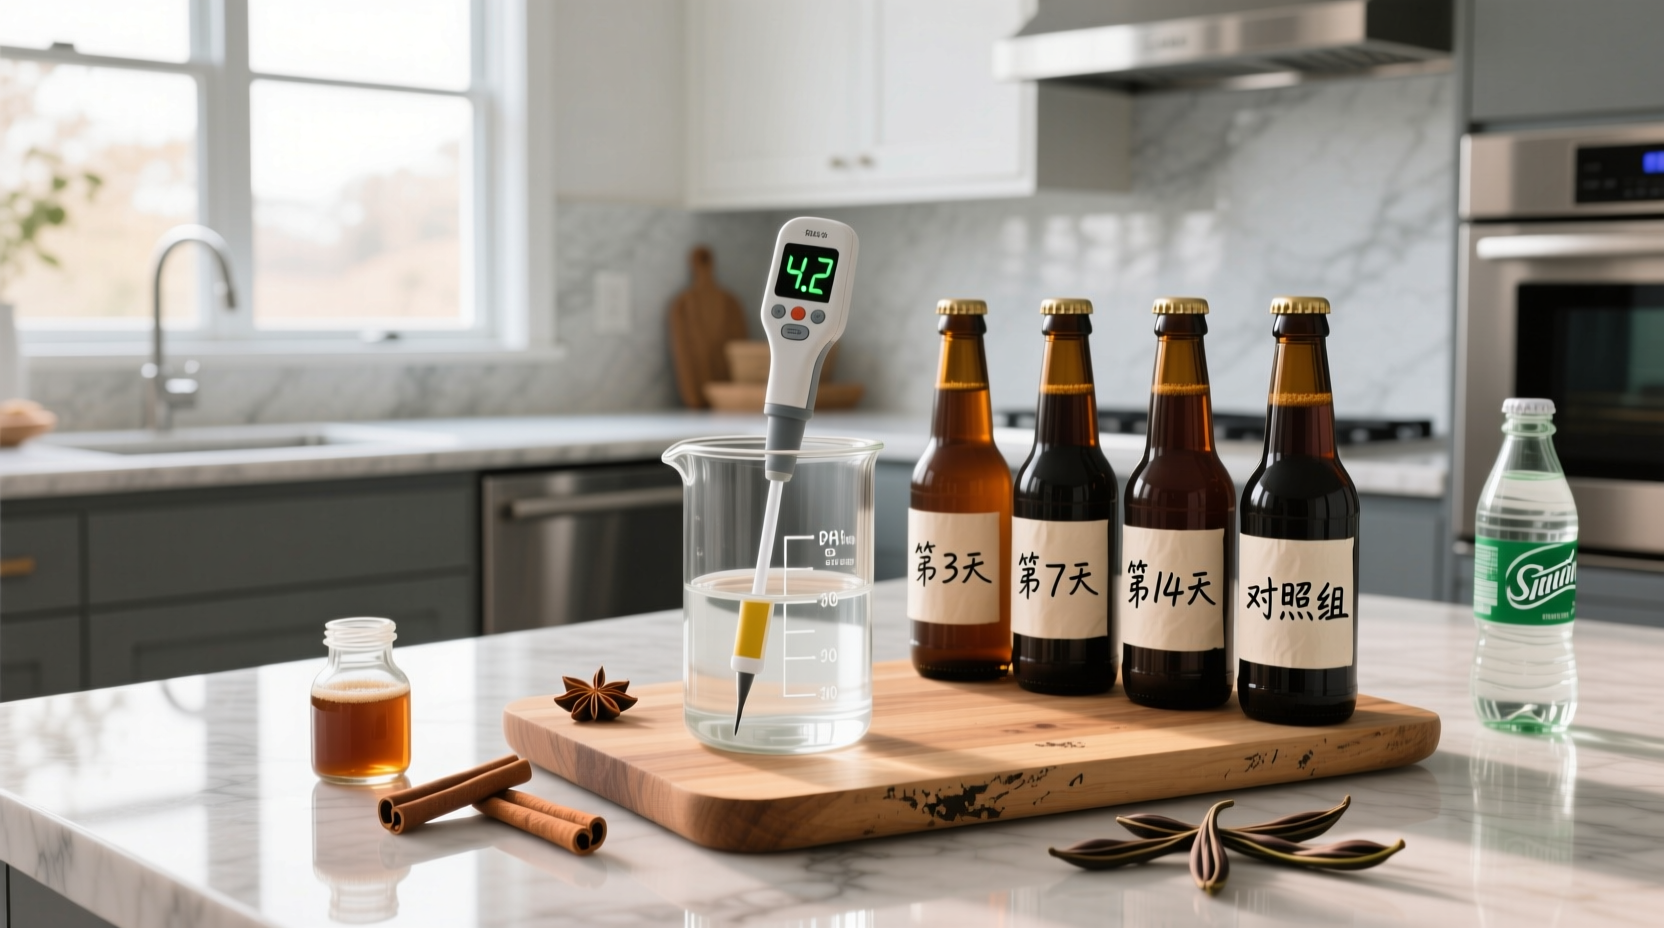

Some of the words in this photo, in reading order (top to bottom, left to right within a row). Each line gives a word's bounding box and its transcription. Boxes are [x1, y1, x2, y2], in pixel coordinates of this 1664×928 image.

[786, 255, 834, 295] 4.2
[915, 541, 992, 587] 第3天
[1019, 552, 1099, 599] 第7天
[1128, 559, 1216, 609] 第14天
[1247, 577, 1349, 621] 对照组
